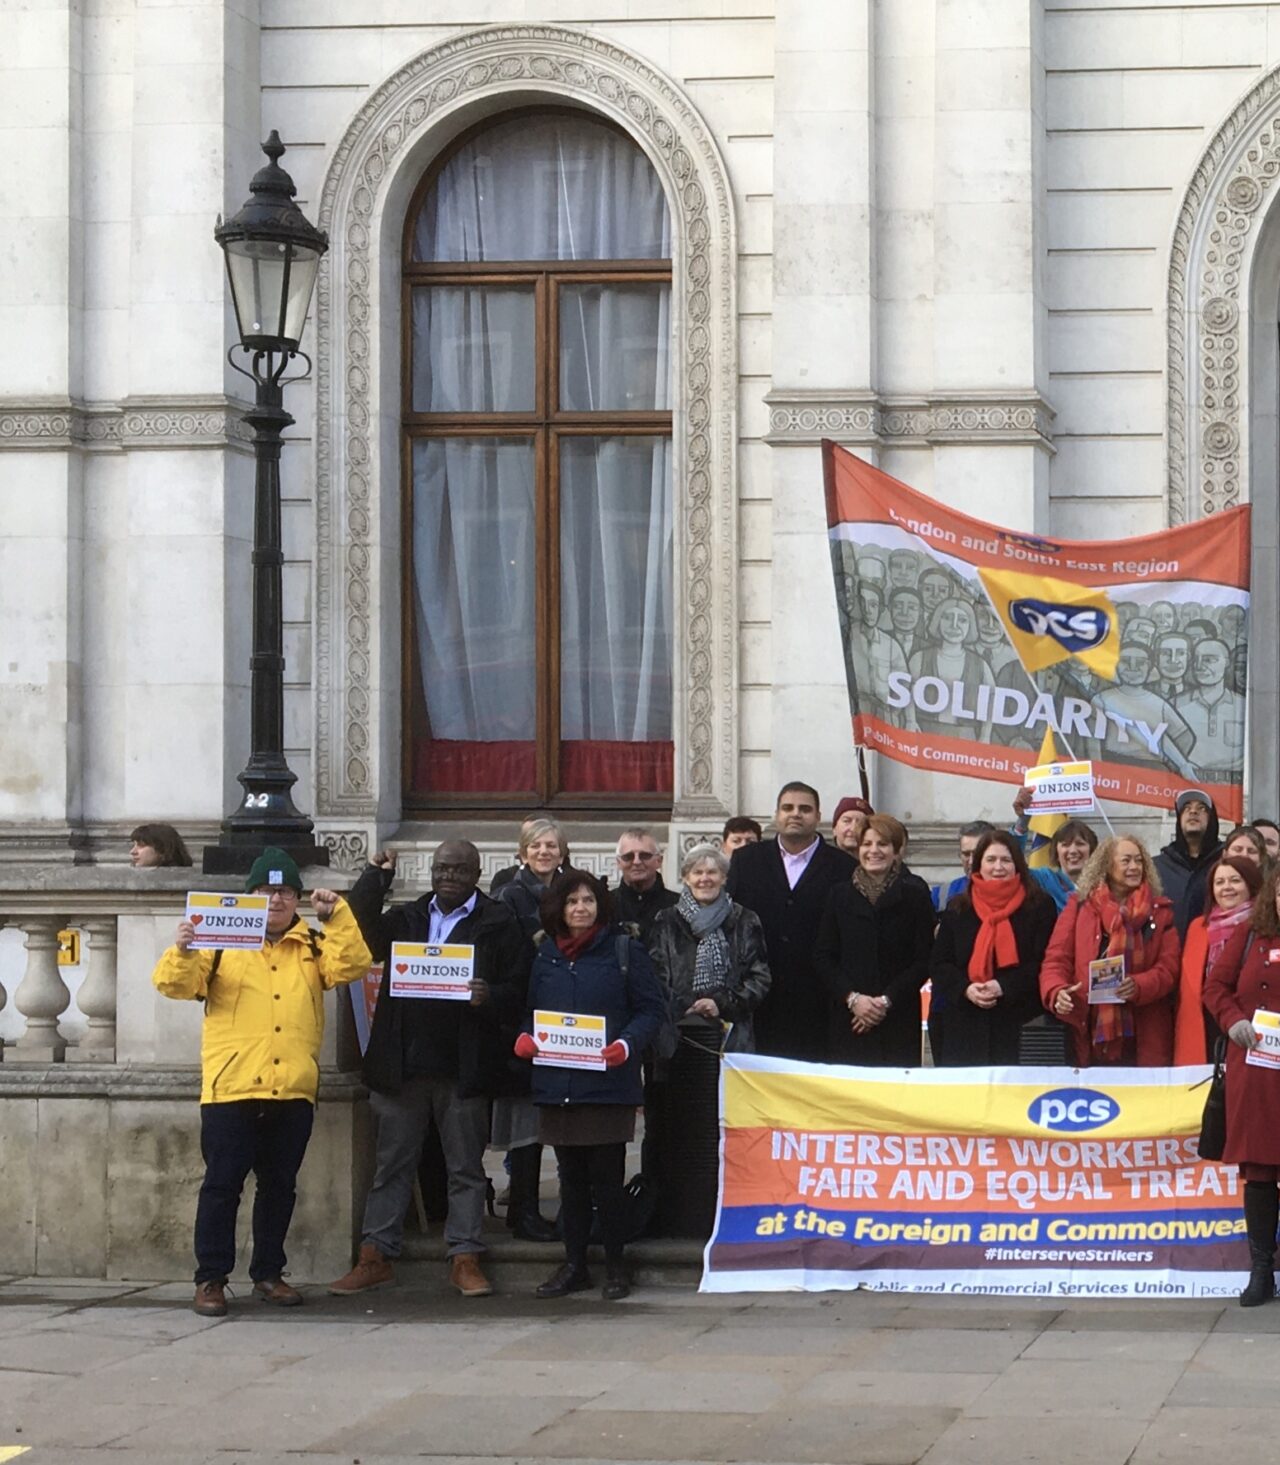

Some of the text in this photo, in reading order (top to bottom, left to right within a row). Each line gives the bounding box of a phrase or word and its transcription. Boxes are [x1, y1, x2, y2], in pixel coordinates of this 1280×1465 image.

[888, 507, 957, 544] Lndon
[961, 534, 1000, 554] and
[1003, 543, 1060, 567] South
[1112, 558, 1180, 577] Region
[886, 671, 1169, 756] SOLIDARITY
[863, 726, 896, 748] Pblic
[897, 741, 919, 757] and
[922, 747, 1009, 772] Commercial
[1038, 781, 1090, 794] UNIONS
[205, 914, 264, 929] UNIONS
[410, 964, 470, 977] UNIONS
[550, 1033, 603, 1048] UNIONS
[1038, 1097, 1111, 1130] pcs
[771, 1130, 1201, 1169] INTERSERVE WORKERS
[798, 1166, 877, 1198] FAIR
[889, 1170, 975, 1201] AND
[986, 1170, 1112, 1210] EQUAL
[756, 1213, 787, 1236] at
[793, 1209, 847, 1237] the
[854, 1217, 971, 1246] Foreign
[980, 1219, 1039, 1241] and
[984, 1247, 1154, 1262] #InterserveStrikers
[950, 1281, 1052, 1294] Commercial
[1057, 1281, 1128, 1294] Services
[1134, 1281, 1186, 1294] Union
